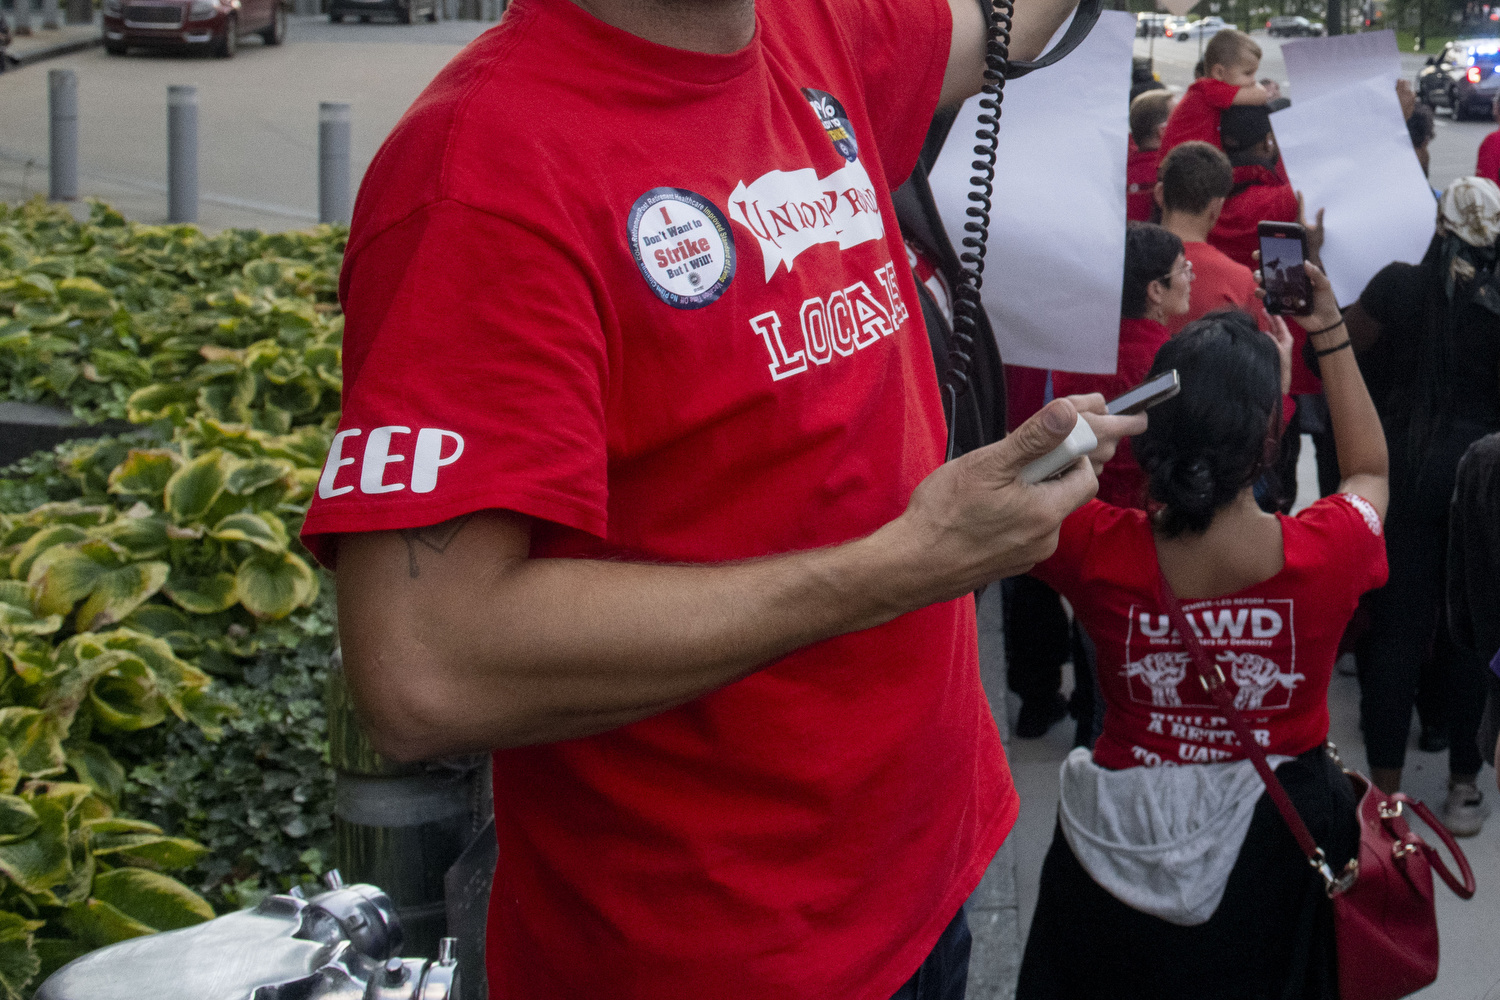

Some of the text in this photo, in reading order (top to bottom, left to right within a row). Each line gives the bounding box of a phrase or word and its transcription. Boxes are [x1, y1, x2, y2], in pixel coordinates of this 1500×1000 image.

[637, 193, 705, 215] Post Retirement Healthcare
[659, 206, 672, 226] I
[642, 219, 703, 247] Don't Want to
[703, 206, 724, 233] Improved
[719, 263, 732, 283] Living
[654, 237, 711, 269] Strike
[666, 253, 714, 279] But I Will!
[669, 293, 679, 303] No
[1171, 722, 1271, 747] BETTR
